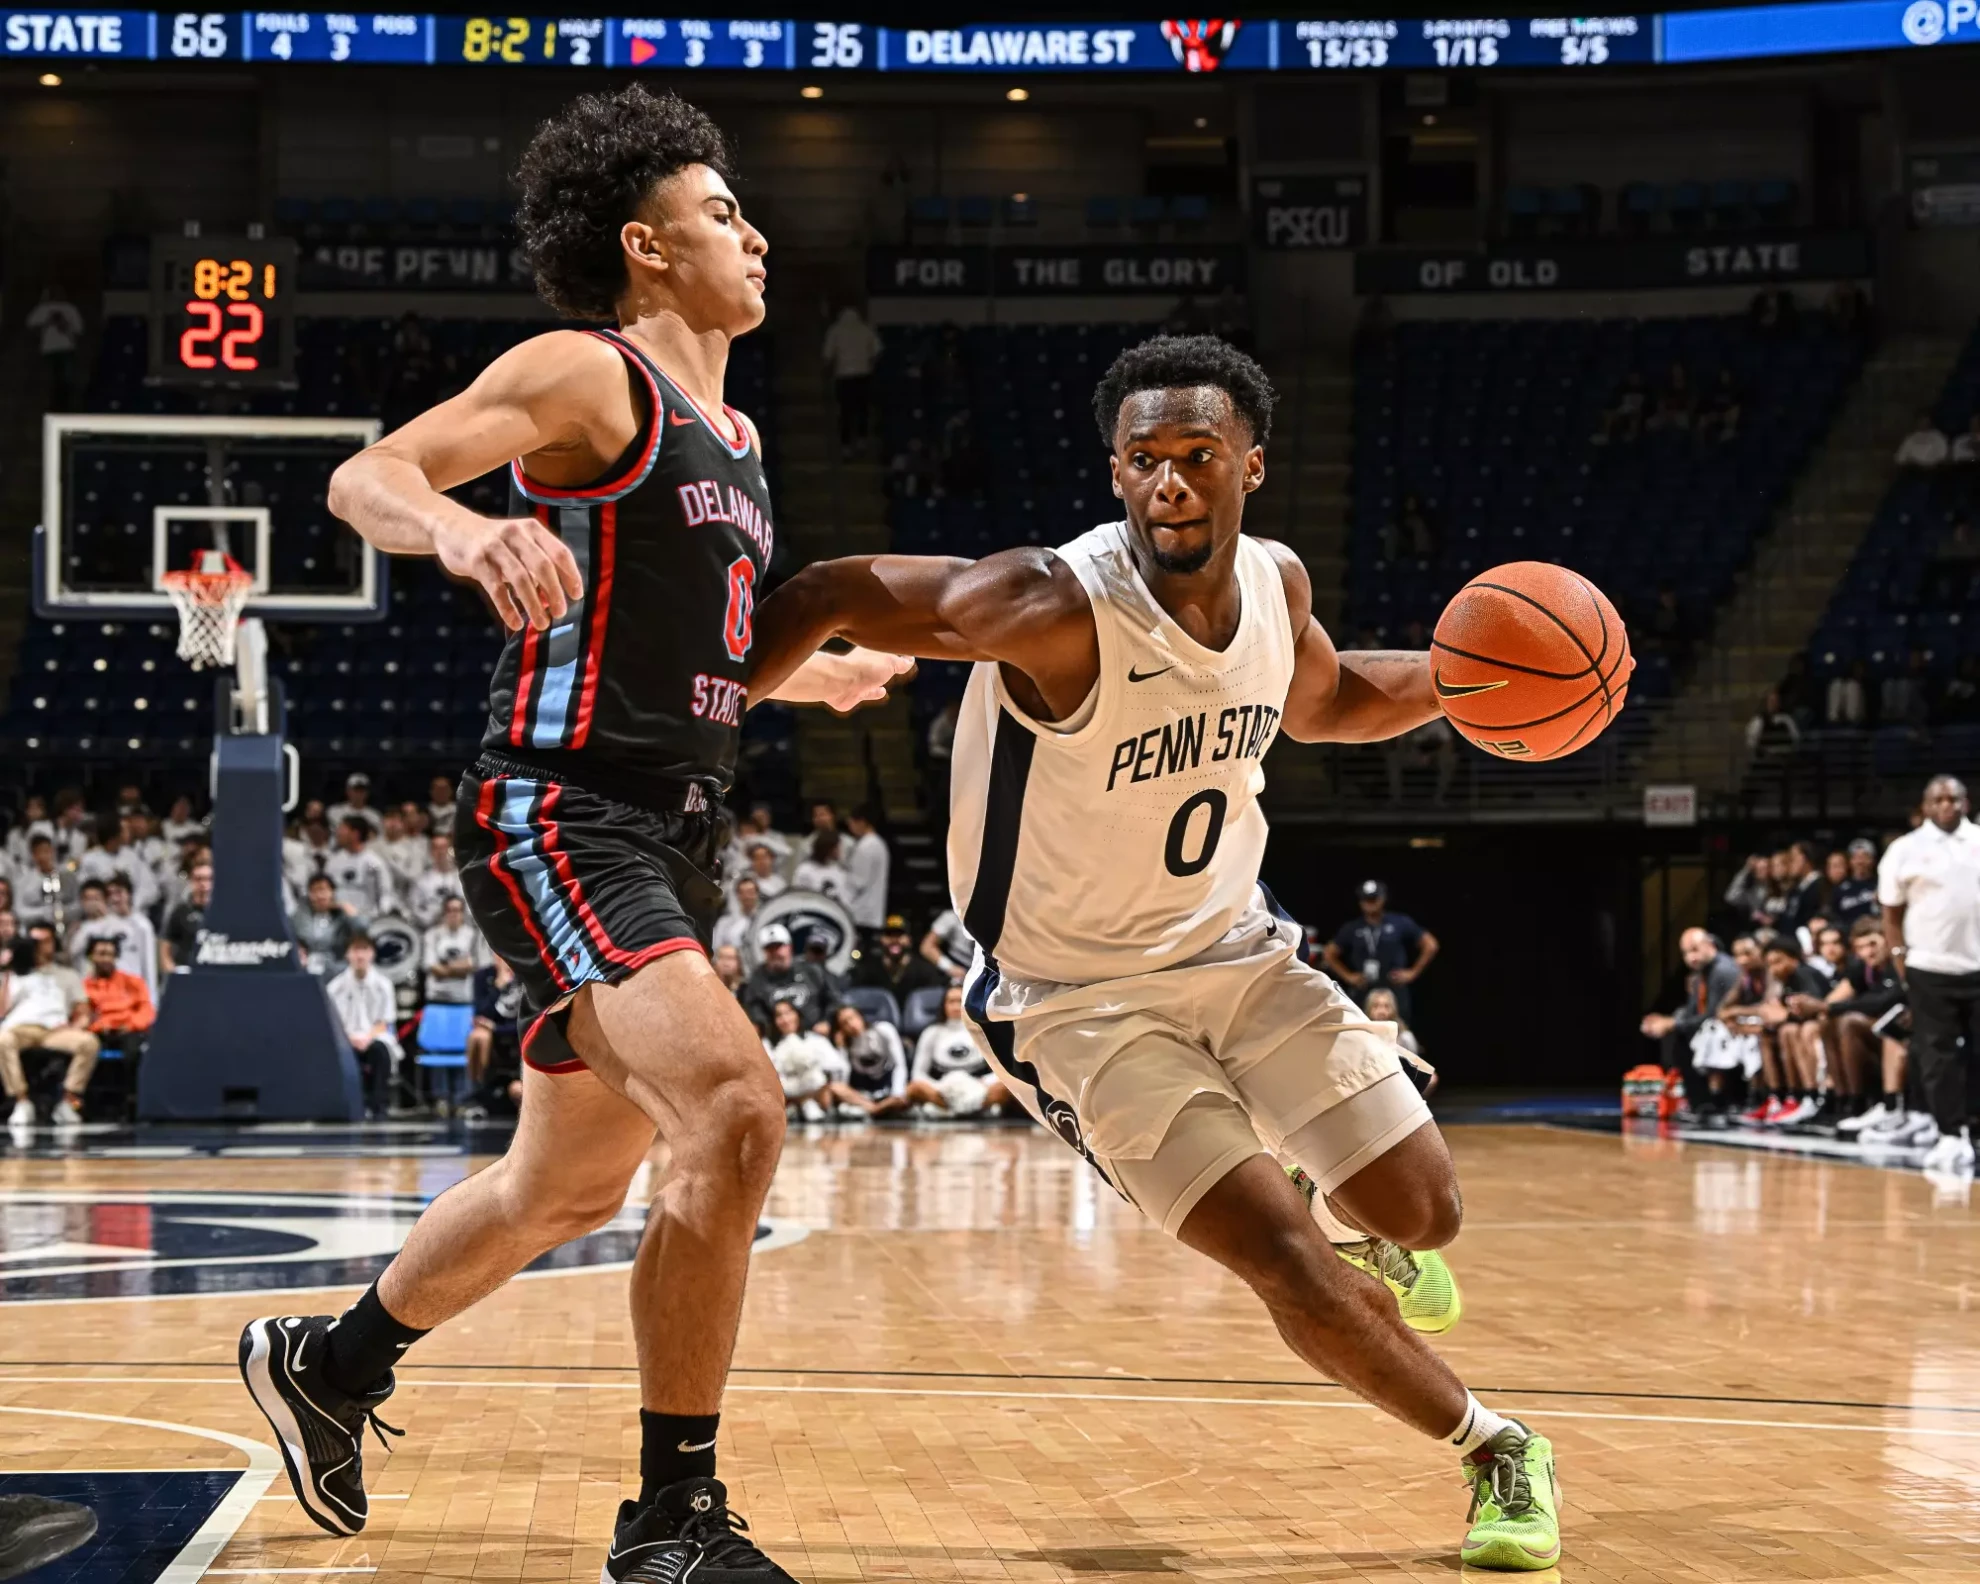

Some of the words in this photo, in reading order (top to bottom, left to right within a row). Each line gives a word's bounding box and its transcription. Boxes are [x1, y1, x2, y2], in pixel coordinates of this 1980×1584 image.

[5, 15, 123, 52] STATE
[171, 14, 227, 57] 66
[463, 18, 556, 62] 8:21
[1902, 0, 1980, 46] @P
[271, 32, 292, 60] 4
[330, 33, 350, 61] 3
[570, 37, 591, 65] 2
[685, 39, 705, 67] 3
[743, 39, 764, 68] 3
[811, 22, 862, 68] 36
[906, 30, 1089, 64] DELAWARE
[1092, 30, 1135, 64] ST
[1306, 37, 1388, 68] 15/53
[1433, 37, 1499, 67] 1/15
[1561, 36, 1609, 65] 5/5
[195, 259, 276, 300] 8:21
[896, 259, 964, 286] FOR
[1013, 258, 1081, 285] THE
[1104, 257, 1220, 286] GLORY
[1420, 260, 1465, 287] OF
[1489, 260, 1557, 286] OLD
[1687, 243, 1799, 275] STATE
[180, 301, 264, 371] 22
[677, 480, 774, 573] DELAWAR
[723, 553, 756, 663] 0
[1106, 713, 1206, 792] PENN
[1212, 704, 1280, 761] STATE
[1164, 788, 1228, 877] 0
